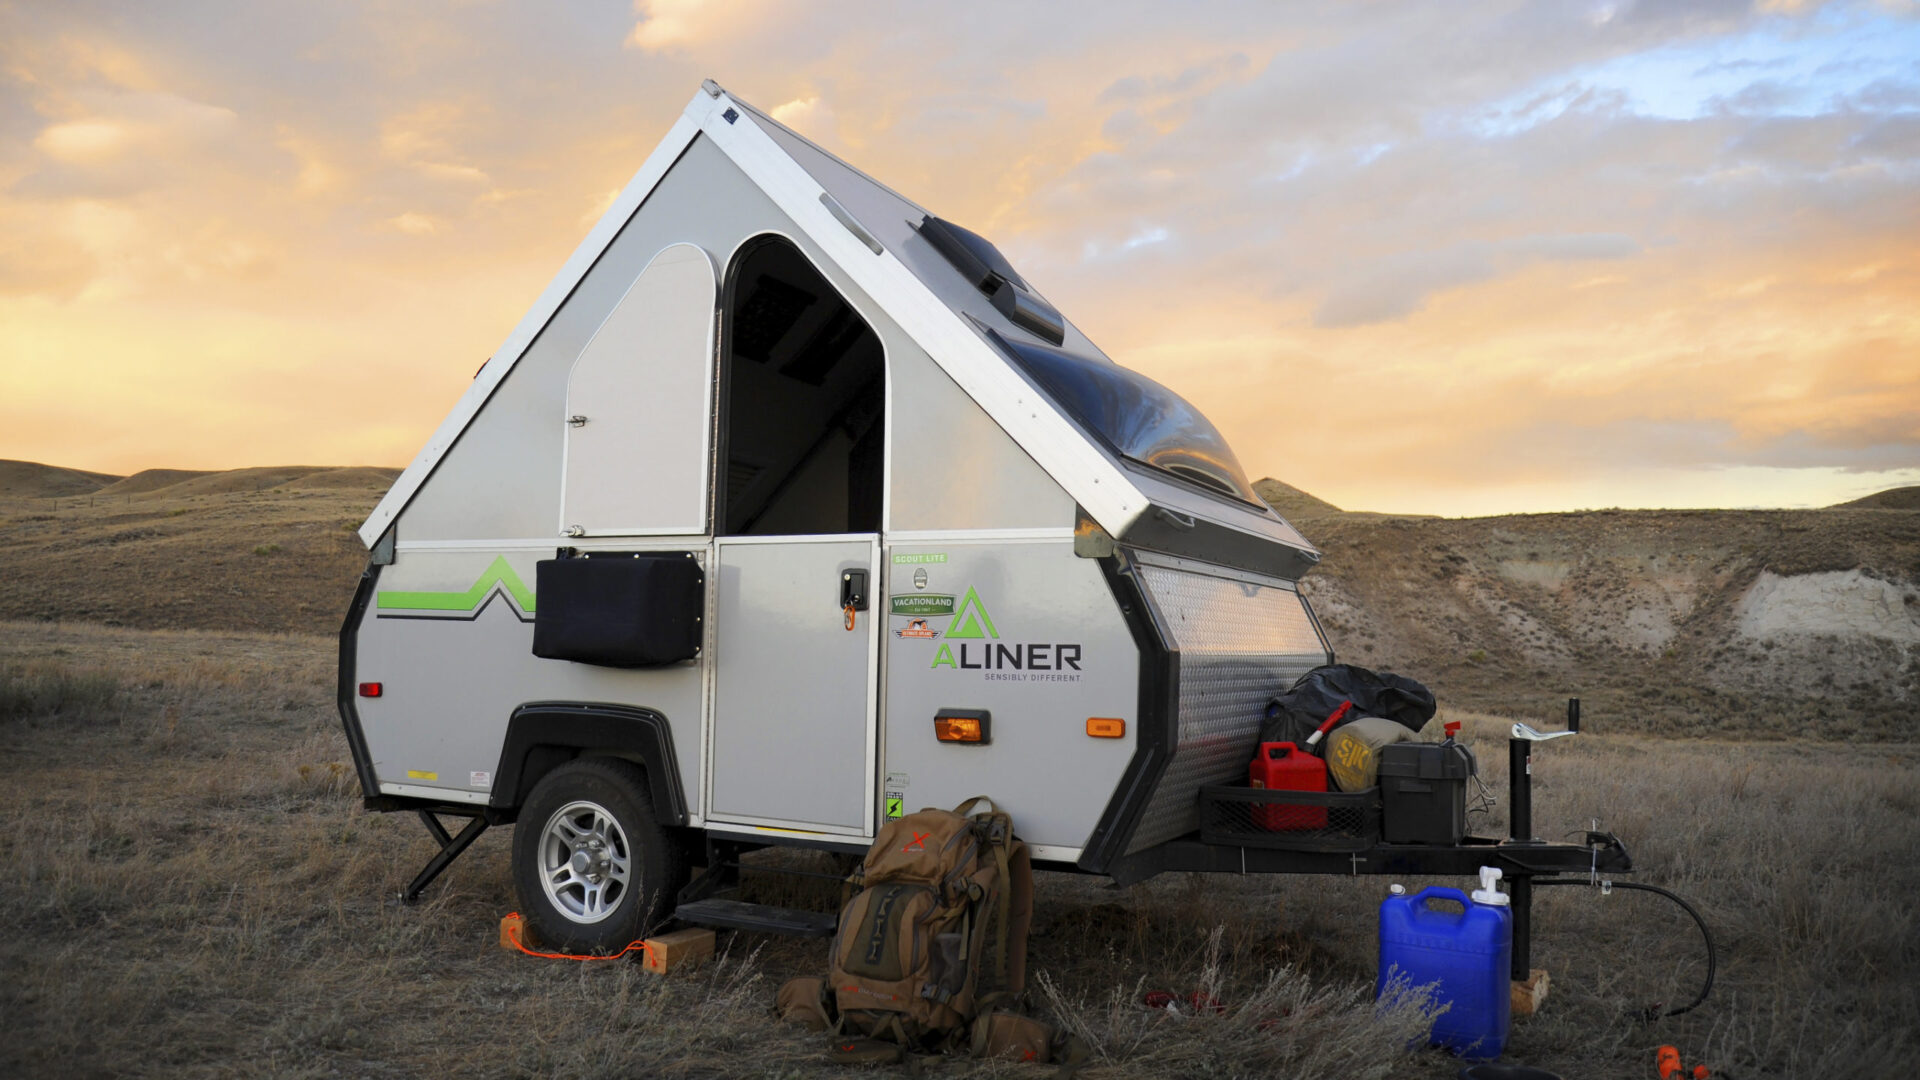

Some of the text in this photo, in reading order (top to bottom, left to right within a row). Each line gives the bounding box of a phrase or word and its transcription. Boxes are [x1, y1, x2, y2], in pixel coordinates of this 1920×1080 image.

[895, 554, 945, 563] SCOUT LITE
[894, 597, 952, 606] VACATIONLAND
[931, 643, 1082, 671] ALINER
[984, 673, 1028, 682] SENSIBLY
